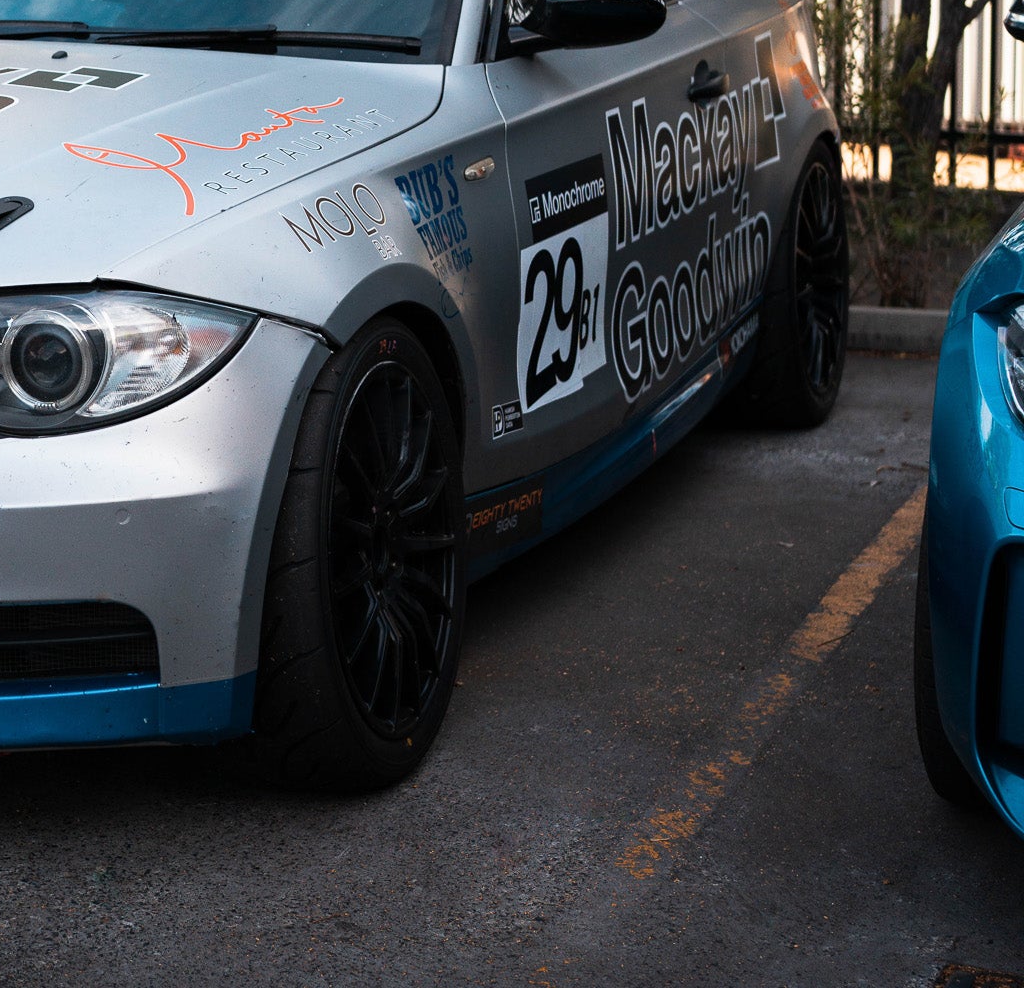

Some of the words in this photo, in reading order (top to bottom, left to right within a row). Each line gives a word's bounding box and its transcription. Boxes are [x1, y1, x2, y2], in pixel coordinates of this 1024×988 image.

[204, 108, 396, 195] RESTAURANT
[605, 84, 750, 251] Mackay
[280, 182, 386, 254] MOLO
[394, 154, 459, 226] BUB'S
[541, 176, 605, 215] Monochrome
[416, 206, 468, 261] FAMOUS
[612, 193, 772, 404] Goodwin
[472, 501, 506, 529] EIGHTY
[508, 488, 543, 514] TWENTY
[496, 514, 518, 534] SIGNS
